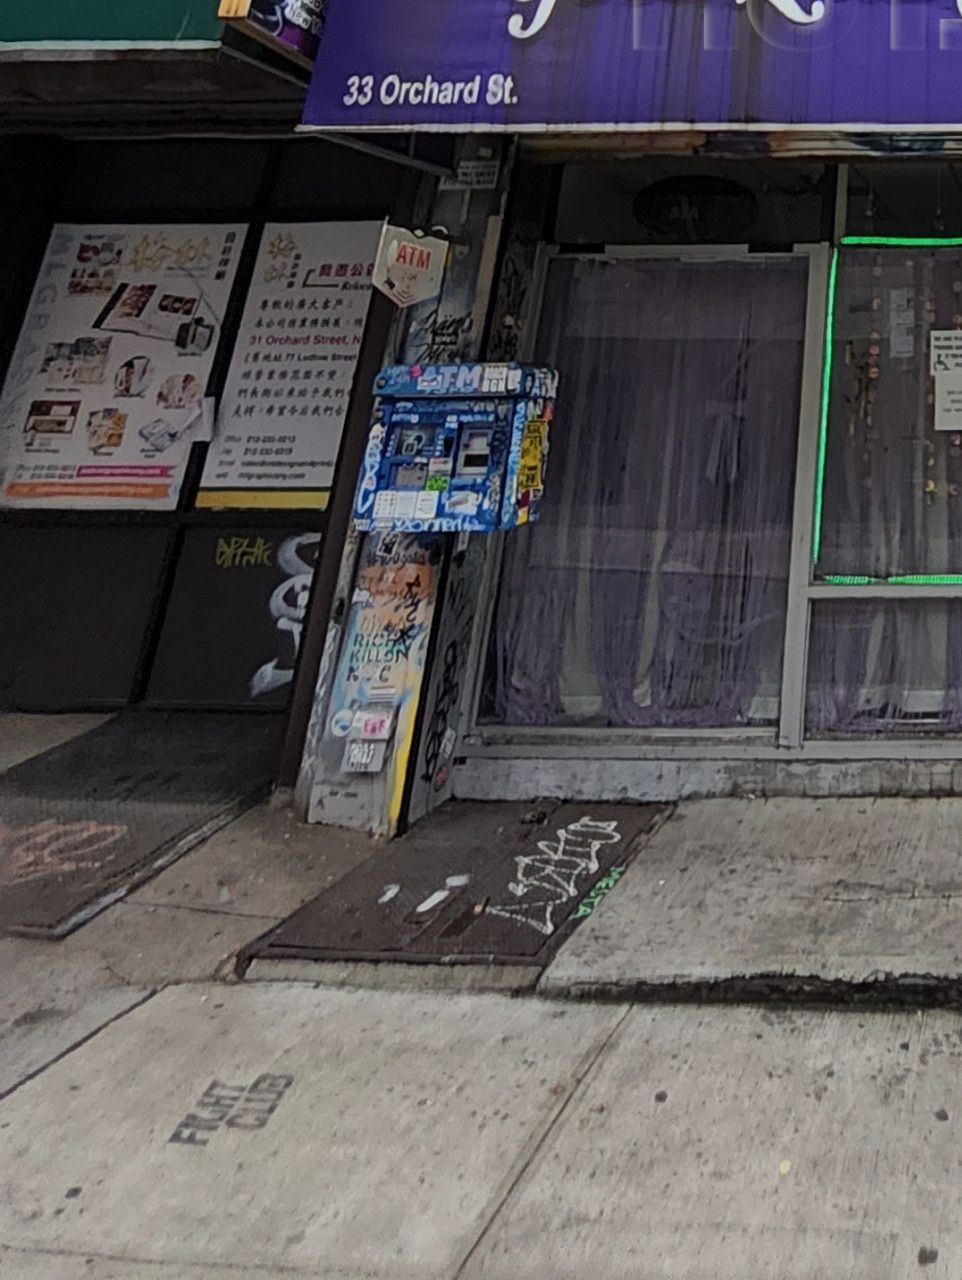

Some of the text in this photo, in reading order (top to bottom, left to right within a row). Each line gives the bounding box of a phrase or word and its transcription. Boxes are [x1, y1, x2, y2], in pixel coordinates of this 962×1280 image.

[343, 73, 518, 106] 33 Orchard St.
[394, 243, 432, 270] ATM
[266, 335, 311, 346] Orchard
